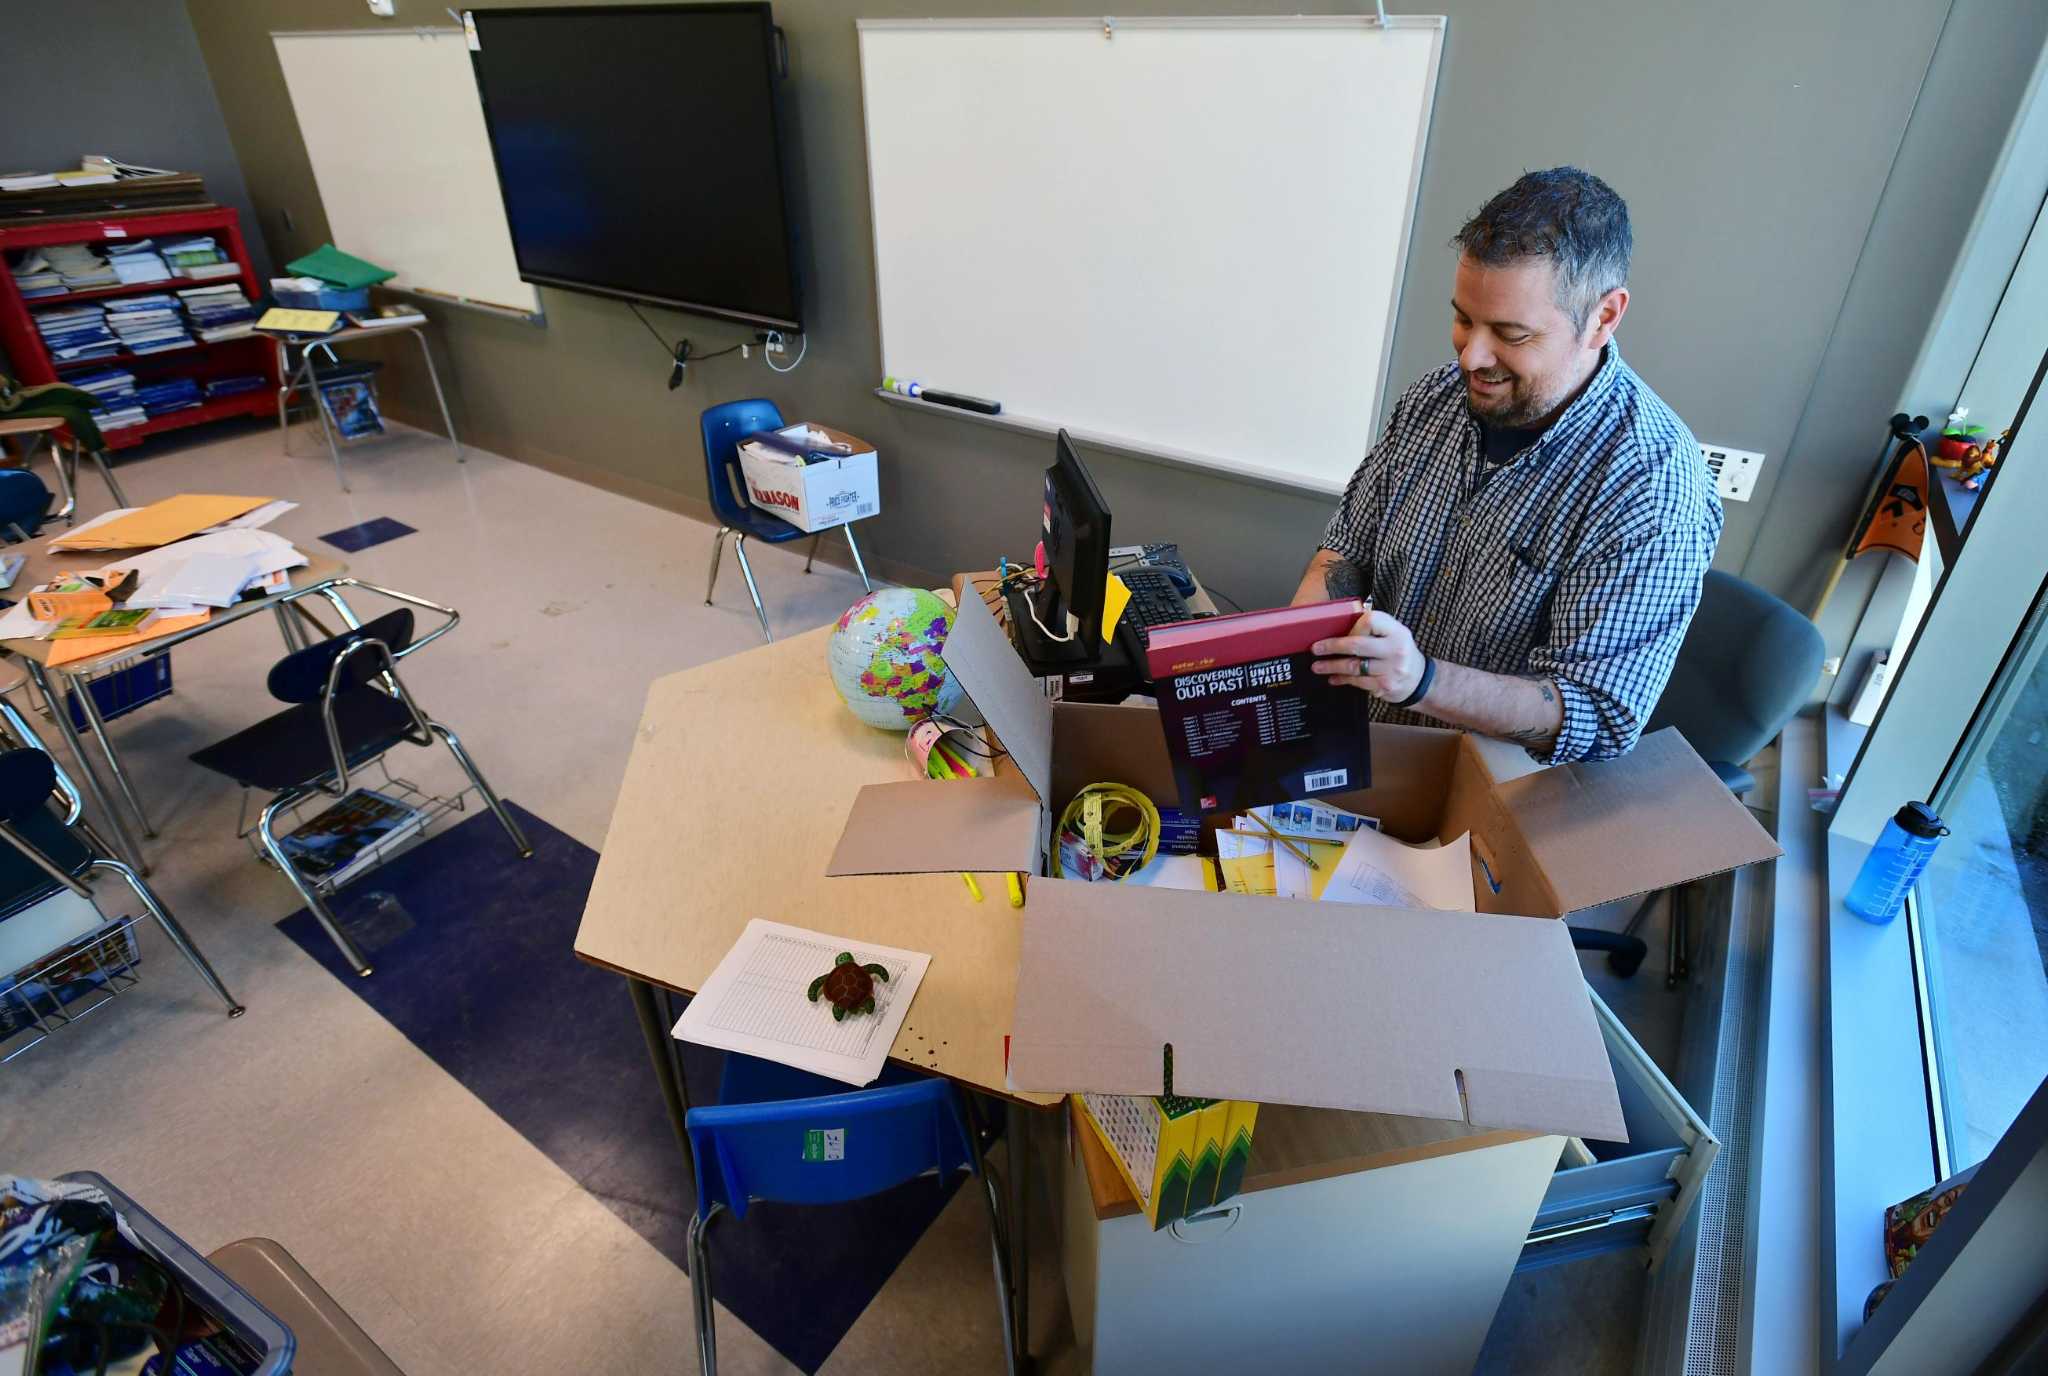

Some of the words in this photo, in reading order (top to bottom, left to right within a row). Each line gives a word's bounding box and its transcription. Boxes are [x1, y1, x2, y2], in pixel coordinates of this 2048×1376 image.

[1174, 667, 1243, 687] DISCOVERING
[1249, 663, 1291, 677] UNITED
[1250, 671, 1291, 686] STATES
[1176, 684, 1206, 701] OUR
[1209, 676, 1245, 695] PAST
[1231, 694, 1266, 706] CONTENTS
